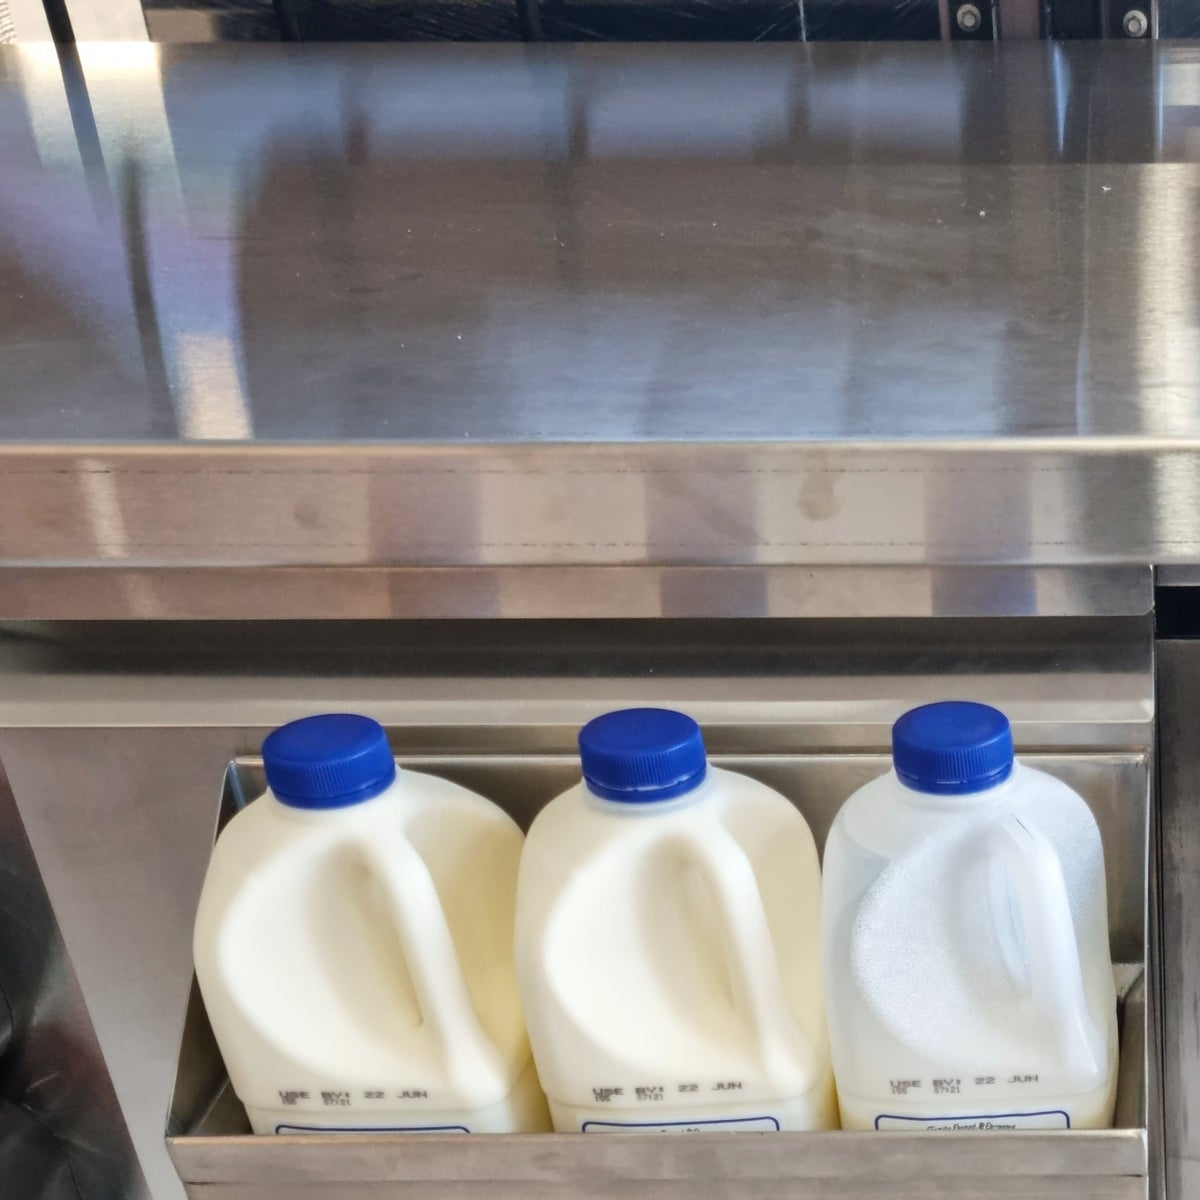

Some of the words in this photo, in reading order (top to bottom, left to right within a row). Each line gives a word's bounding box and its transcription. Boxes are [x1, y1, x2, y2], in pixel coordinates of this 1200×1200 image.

[889, 1079, 922, 1088] USE
[974, 1076, 995, 1085] 22
[1007, 1074, 1039, 1084] JUN
[278, 1090, 310, 1099] USE
[363, 1090, 385, 1099] 22
[397, 1090, 428, 1099] JUN
[592, 1087, 624, 1097] USE
[678, 1084, 699, 1093] 22
[711, 1081, 743, 1091] JUN
